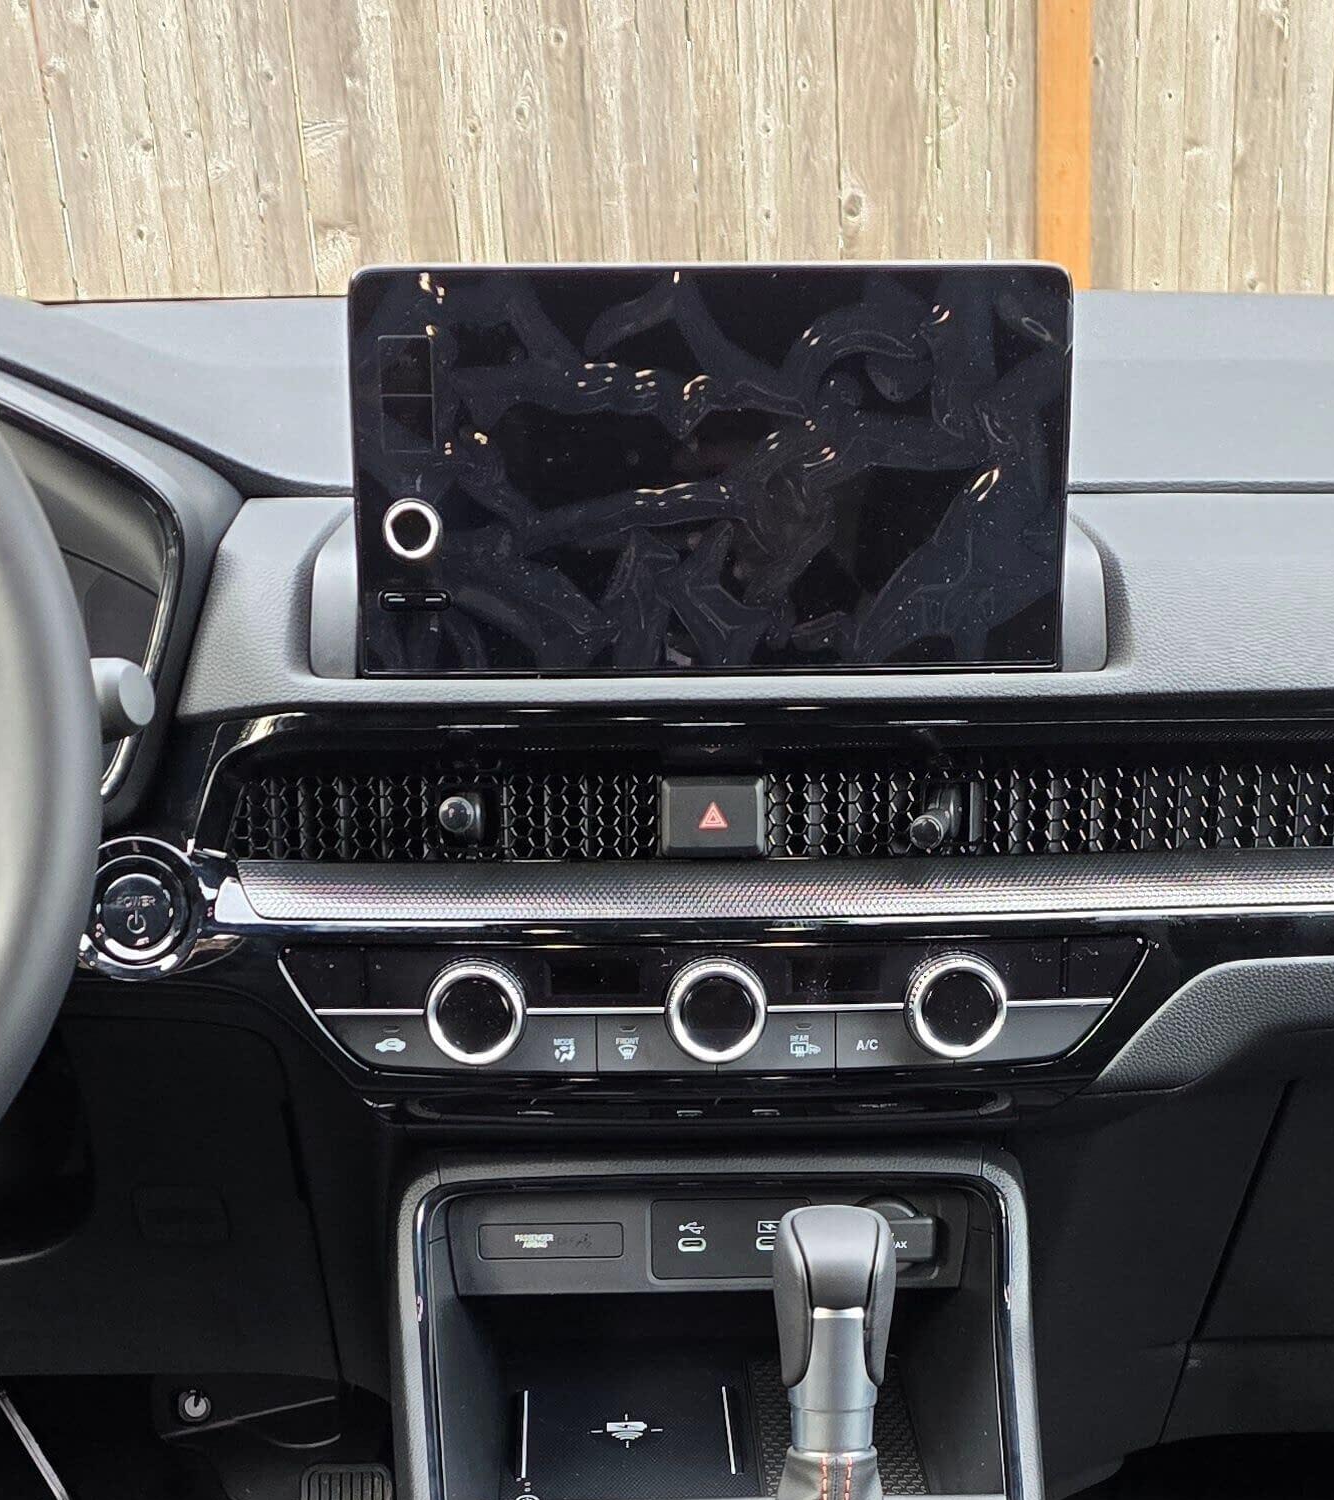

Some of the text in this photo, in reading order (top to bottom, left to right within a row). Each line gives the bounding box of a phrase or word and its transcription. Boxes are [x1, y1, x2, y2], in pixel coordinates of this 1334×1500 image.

[116, 895, 156, 908] POWER
[615, 1037, 640, 1045] FRONT
[856, 1039, 879, 1051] A/C
[893, 1241, 907, 1249] AX
